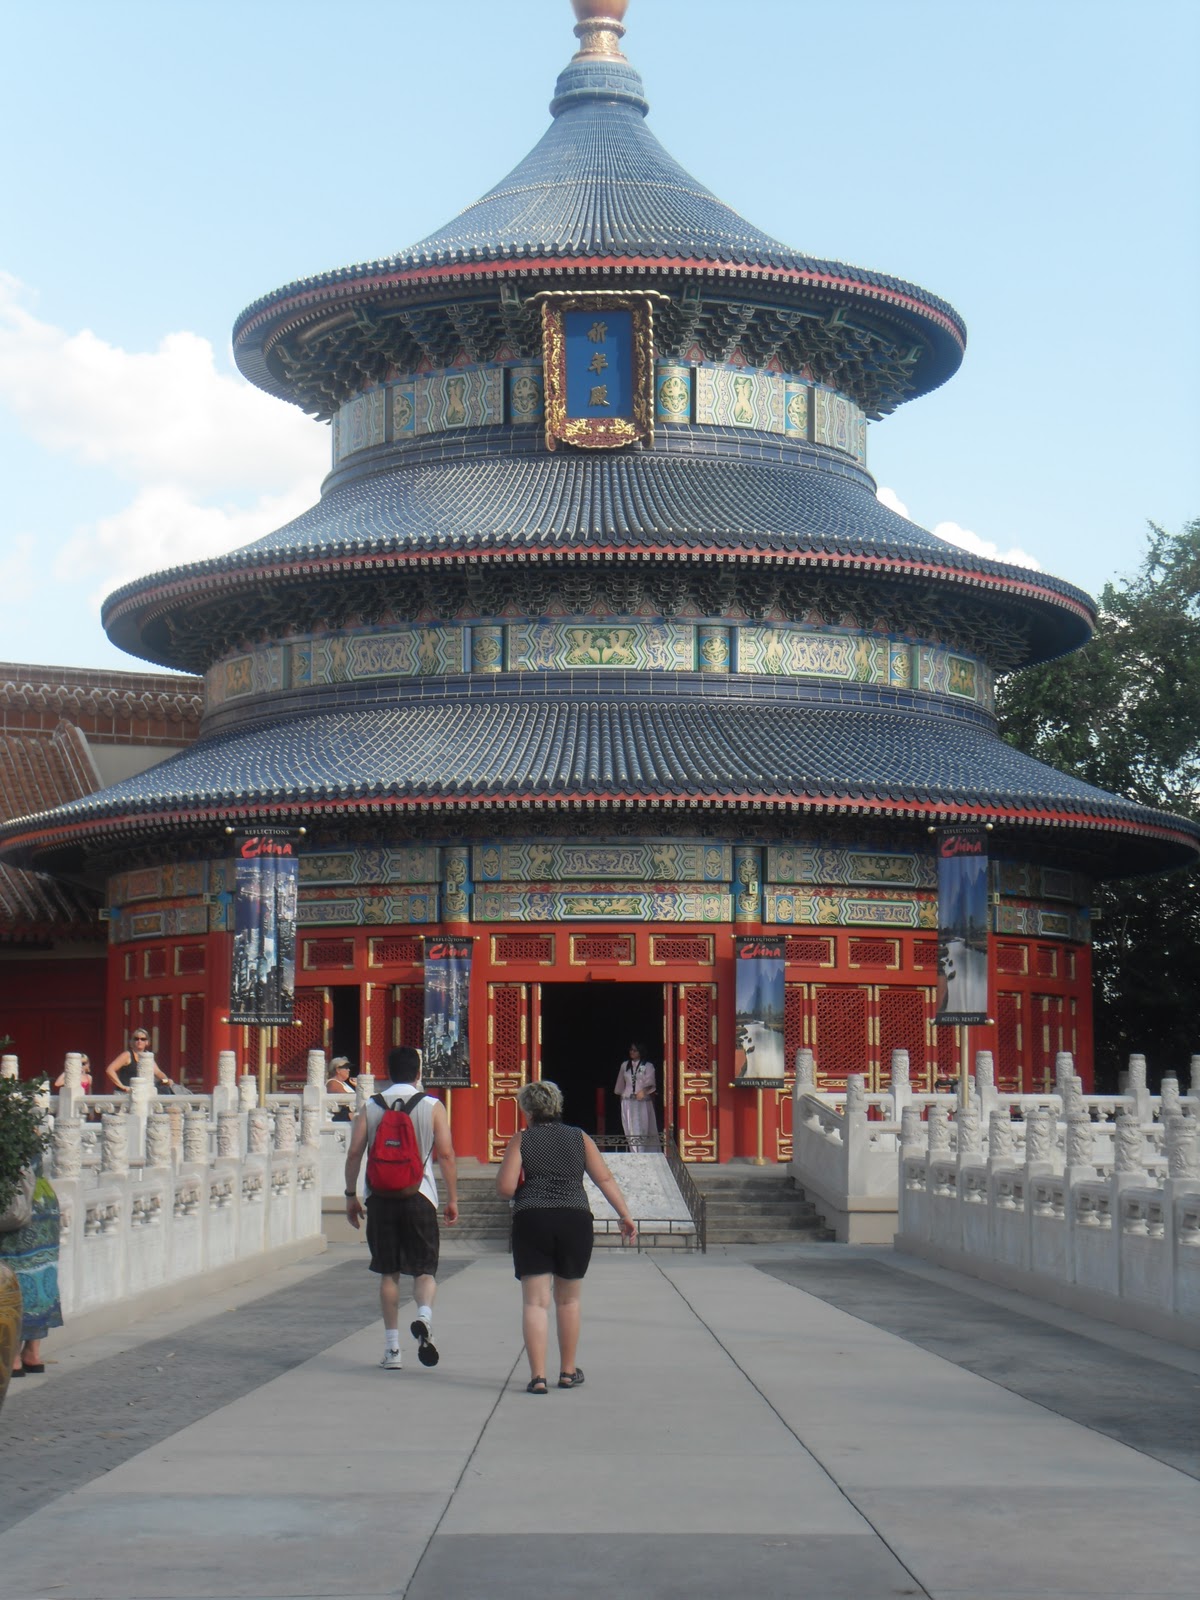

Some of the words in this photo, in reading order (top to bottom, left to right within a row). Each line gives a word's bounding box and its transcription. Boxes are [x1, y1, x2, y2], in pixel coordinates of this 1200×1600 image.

[241, 836, 293, 859] China
[941, 834, 983, 858] China
[429, 943, 468, 960] China
[740, 943, 781, 960] China
